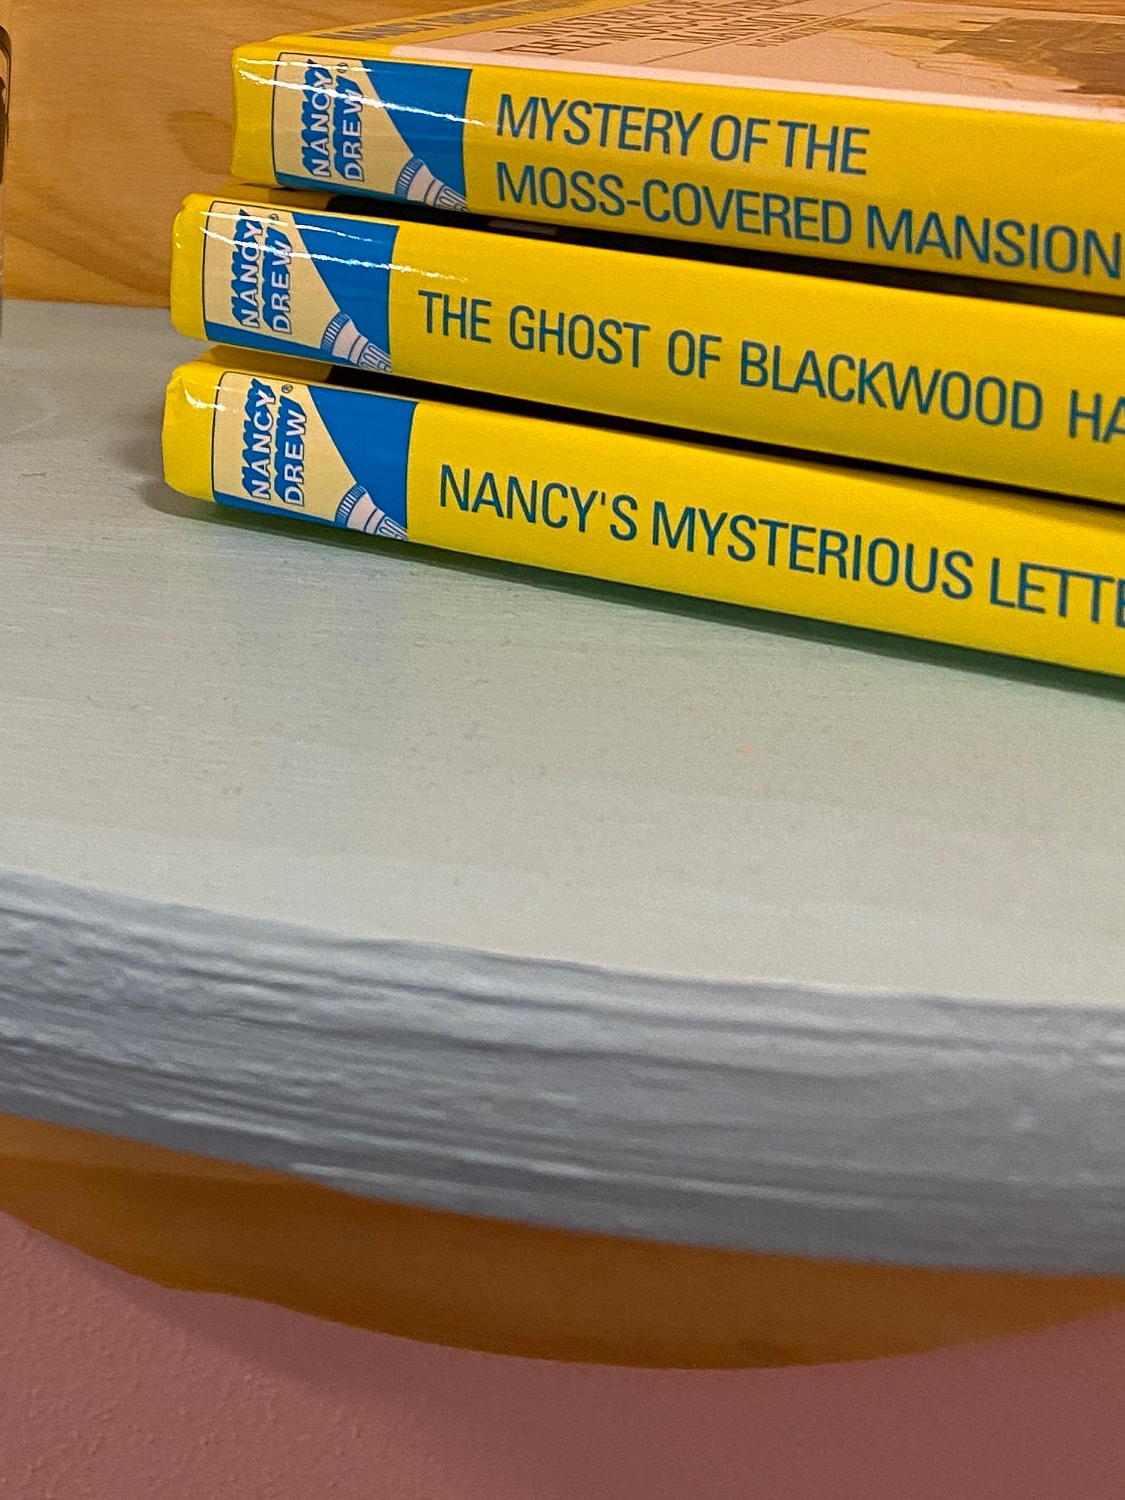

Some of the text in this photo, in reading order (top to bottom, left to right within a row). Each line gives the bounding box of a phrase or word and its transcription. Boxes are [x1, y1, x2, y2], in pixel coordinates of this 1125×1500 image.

[492, 39, 611, 55] THE
[494, 6, 674, 37] MYSTERY
[650, 11, 826, 45] MANSION
[303, 62, 365, 183] NANCY DREW
[497, 93, 871, 176] MYSTERY OF THE
[234, 212, 293, 335] NANCY DREW
[496, 162, 1122, 280] MOSS-COVERED MANSION
[417, 289, 492, 345] THE
[508, 304, 651, 368] GHOST
[666, 329, 723, 380] OF
[740, 340, 1043, 431] BLACKWOOD
[244, 380, 308, 507] NANCY DREW
[440, 464, 638, 542] NANCY'S
[651, 500, 973, 600] MYSTERIOUS
